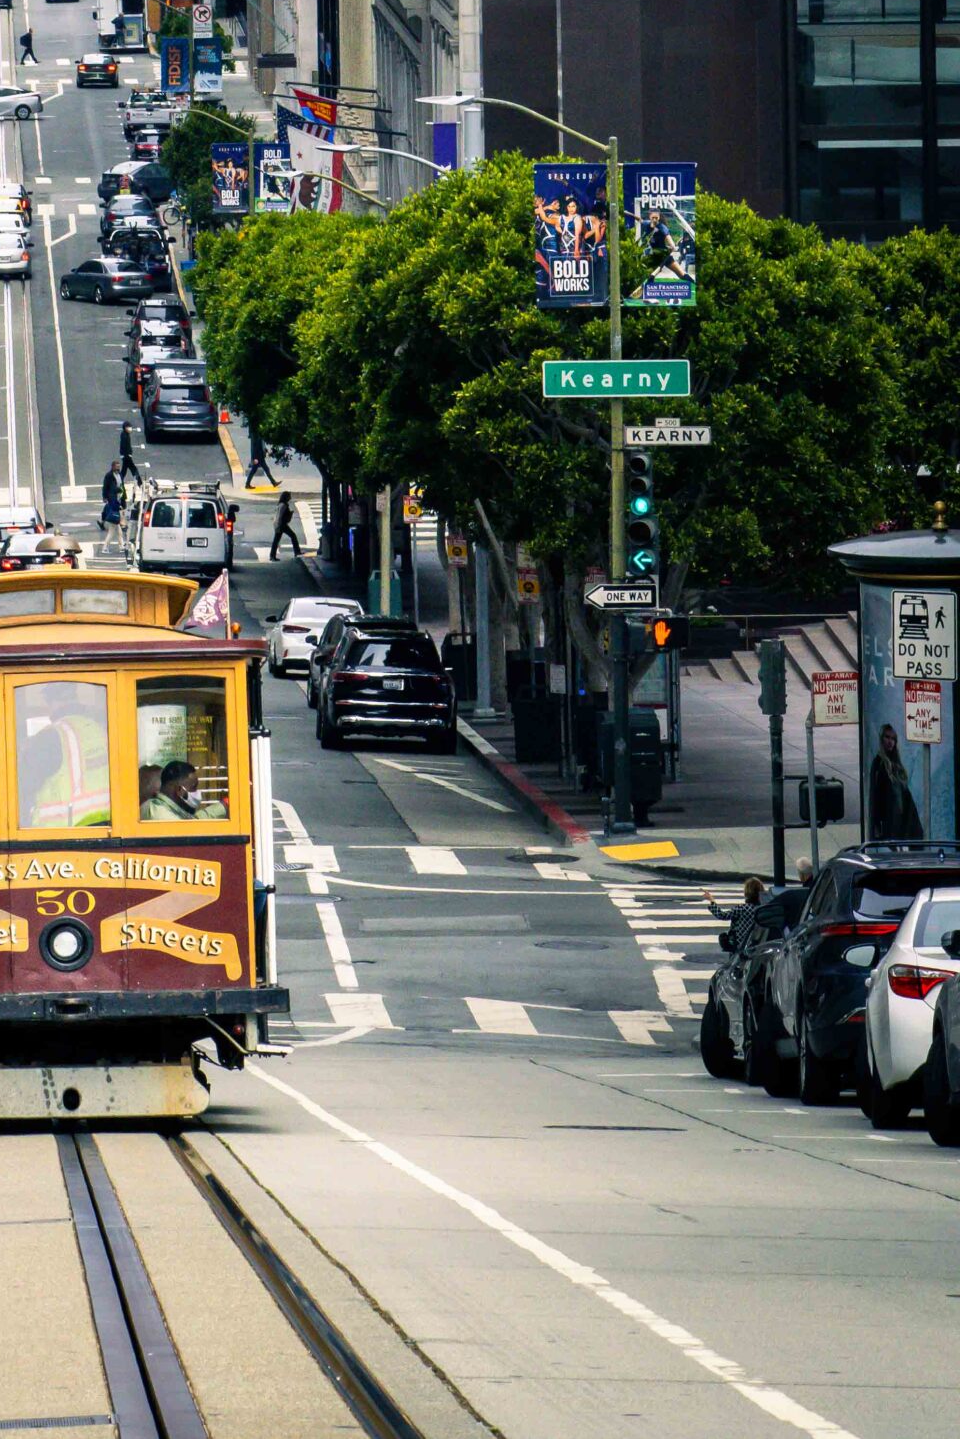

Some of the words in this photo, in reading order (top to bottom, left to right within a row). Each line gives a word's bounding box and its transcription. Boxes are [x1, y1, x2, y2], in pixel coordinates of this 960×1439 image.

[263, 149, 282, 158] BOLD
[641, 176, 677, 194] BOLD
[221, 190, 240, 199] BOLD
[641, 194, 677, 209] PLAYS
[553, 260, 589, 278] BOLD
[553, 278, 590, 292] WORKS
[561, 370, 671, 391] Kearny
[632, 430, 705, 441] KEARNY
[606, 592, 626, 601] ONE
[629, 592, 649, 601] WAY
[898, 643, 916, 656] DO
[924, 645, 950, 658] NOT
[907, 661, 943, 676] PASS
[813, 681, 826, 693] NO
[827, 683, 857, 692] STOPPING
[827, 694, 844, 703] ANY
[906, 690, 916, 702] NO
[917, 692, 941, 704] STOPPING
[826, 705, 847, 713] TIME
[915, 708, 931, 718] ANY
[915, 719, 933, 729] TIME
[94, 857, 216, 887] California
[36, 889, 96, 916] 50
[120, 921, 224, 957] Streets
